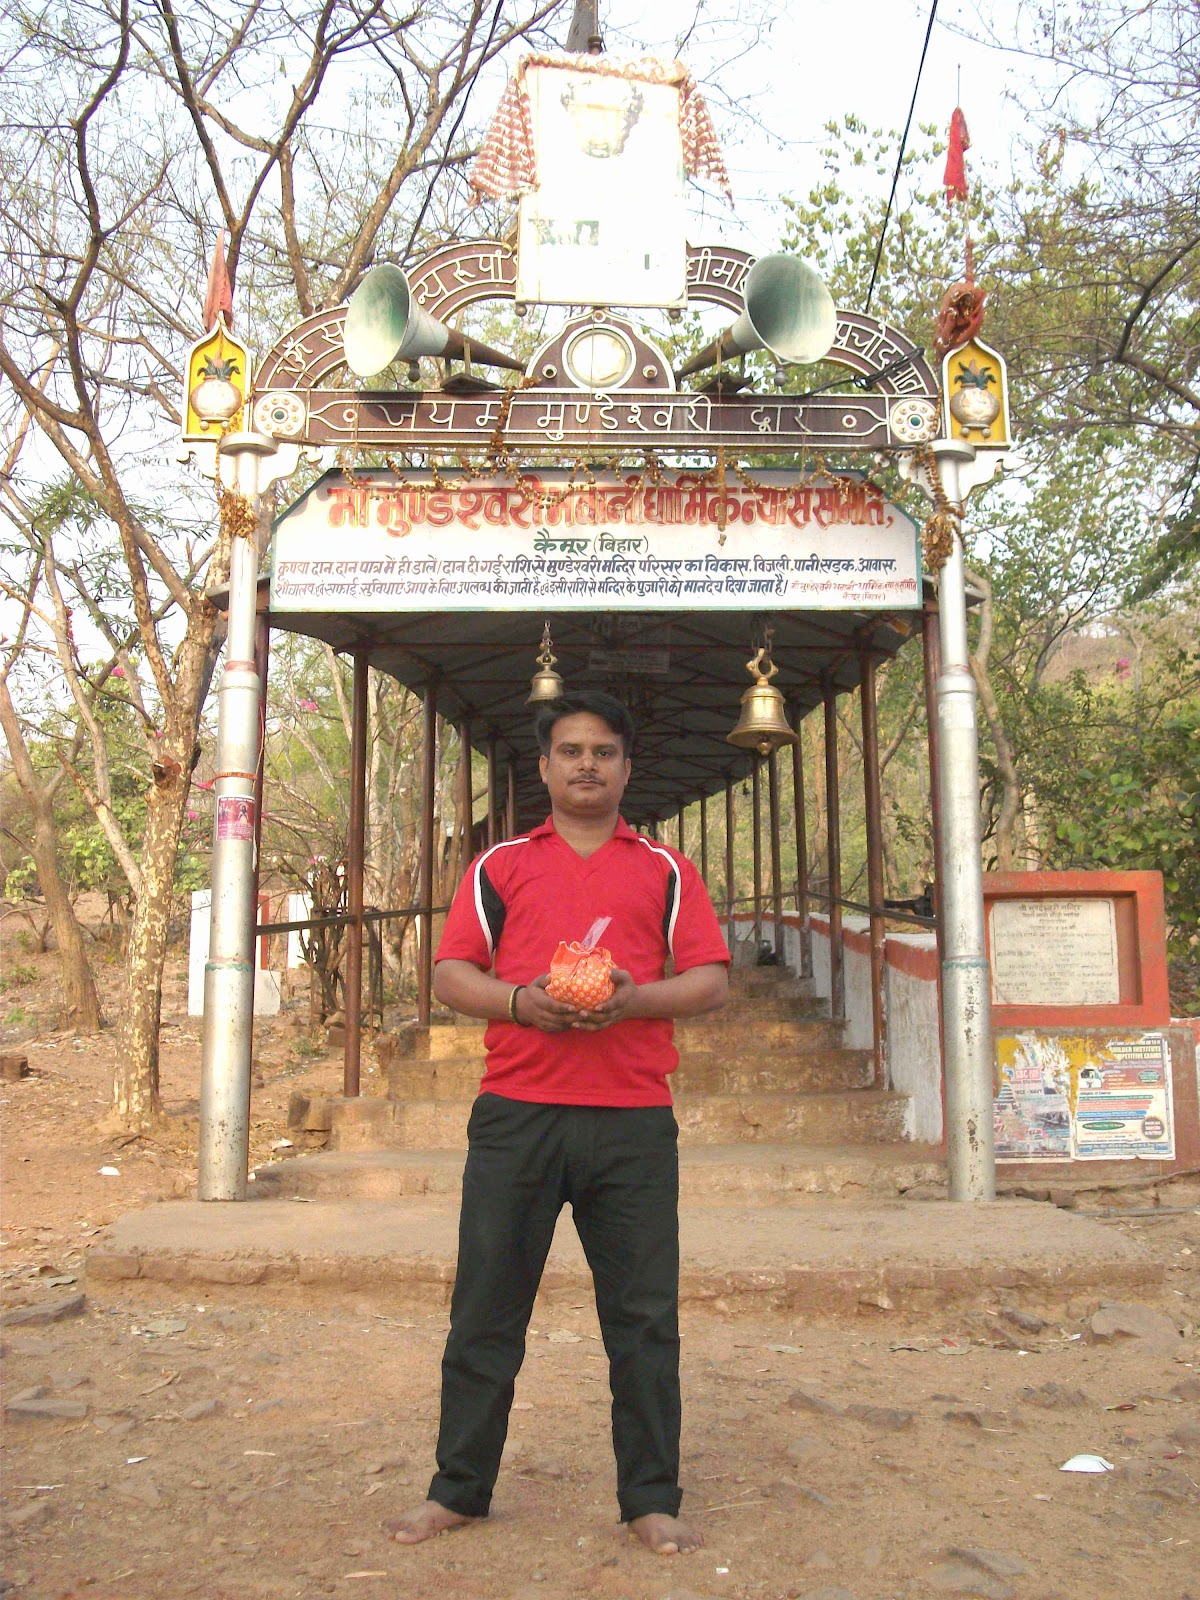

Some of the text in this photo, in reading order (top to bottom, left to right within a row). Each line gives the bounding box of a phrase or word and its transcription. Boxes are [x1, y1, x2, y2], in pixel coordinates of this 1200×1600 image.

[378, 401, 455, 432] जय
[536, 392, 712, 441] मुण्डेश्वरी
[750, 404, 813, 434] द्वार
[376, 474, 543, 538] मुण्डेश्वरी
[533, 528, 650, 556] कैमूर (बिहार)
[336, 560, 358, 578] दान
[359, 560, 384, 576] पात्र
[383, 554, 397, 575] में
[398, 555, 412, 577] ही
[443, 560, 467, 576] दान
[467, 555, 480, 576] दी
[480, 554, 504, 577] गई
[502, 554, 533, 576] राशि
[531, 554, 547, 576] से
[547, 554, 601, 577] मुण्डेश्वरी
[601, 553, 637, 577] मन्दिर
[638, 555, 684, 577] परिसर
[684, 559, 704, 573] का
[404, 580, 428, 596] आप
[427, 578, 439, 596] के
[493, 577, 509, 595] की
[508, 577, 533, 596] जाती
[549, 577, 569, 597] इसी
[567, 577, 588, 597] राशि
[598, 576, 626, 597] मन्दिर
[625, 577, 637, 594] के
[636, 577, 669, 598] पुजारी
